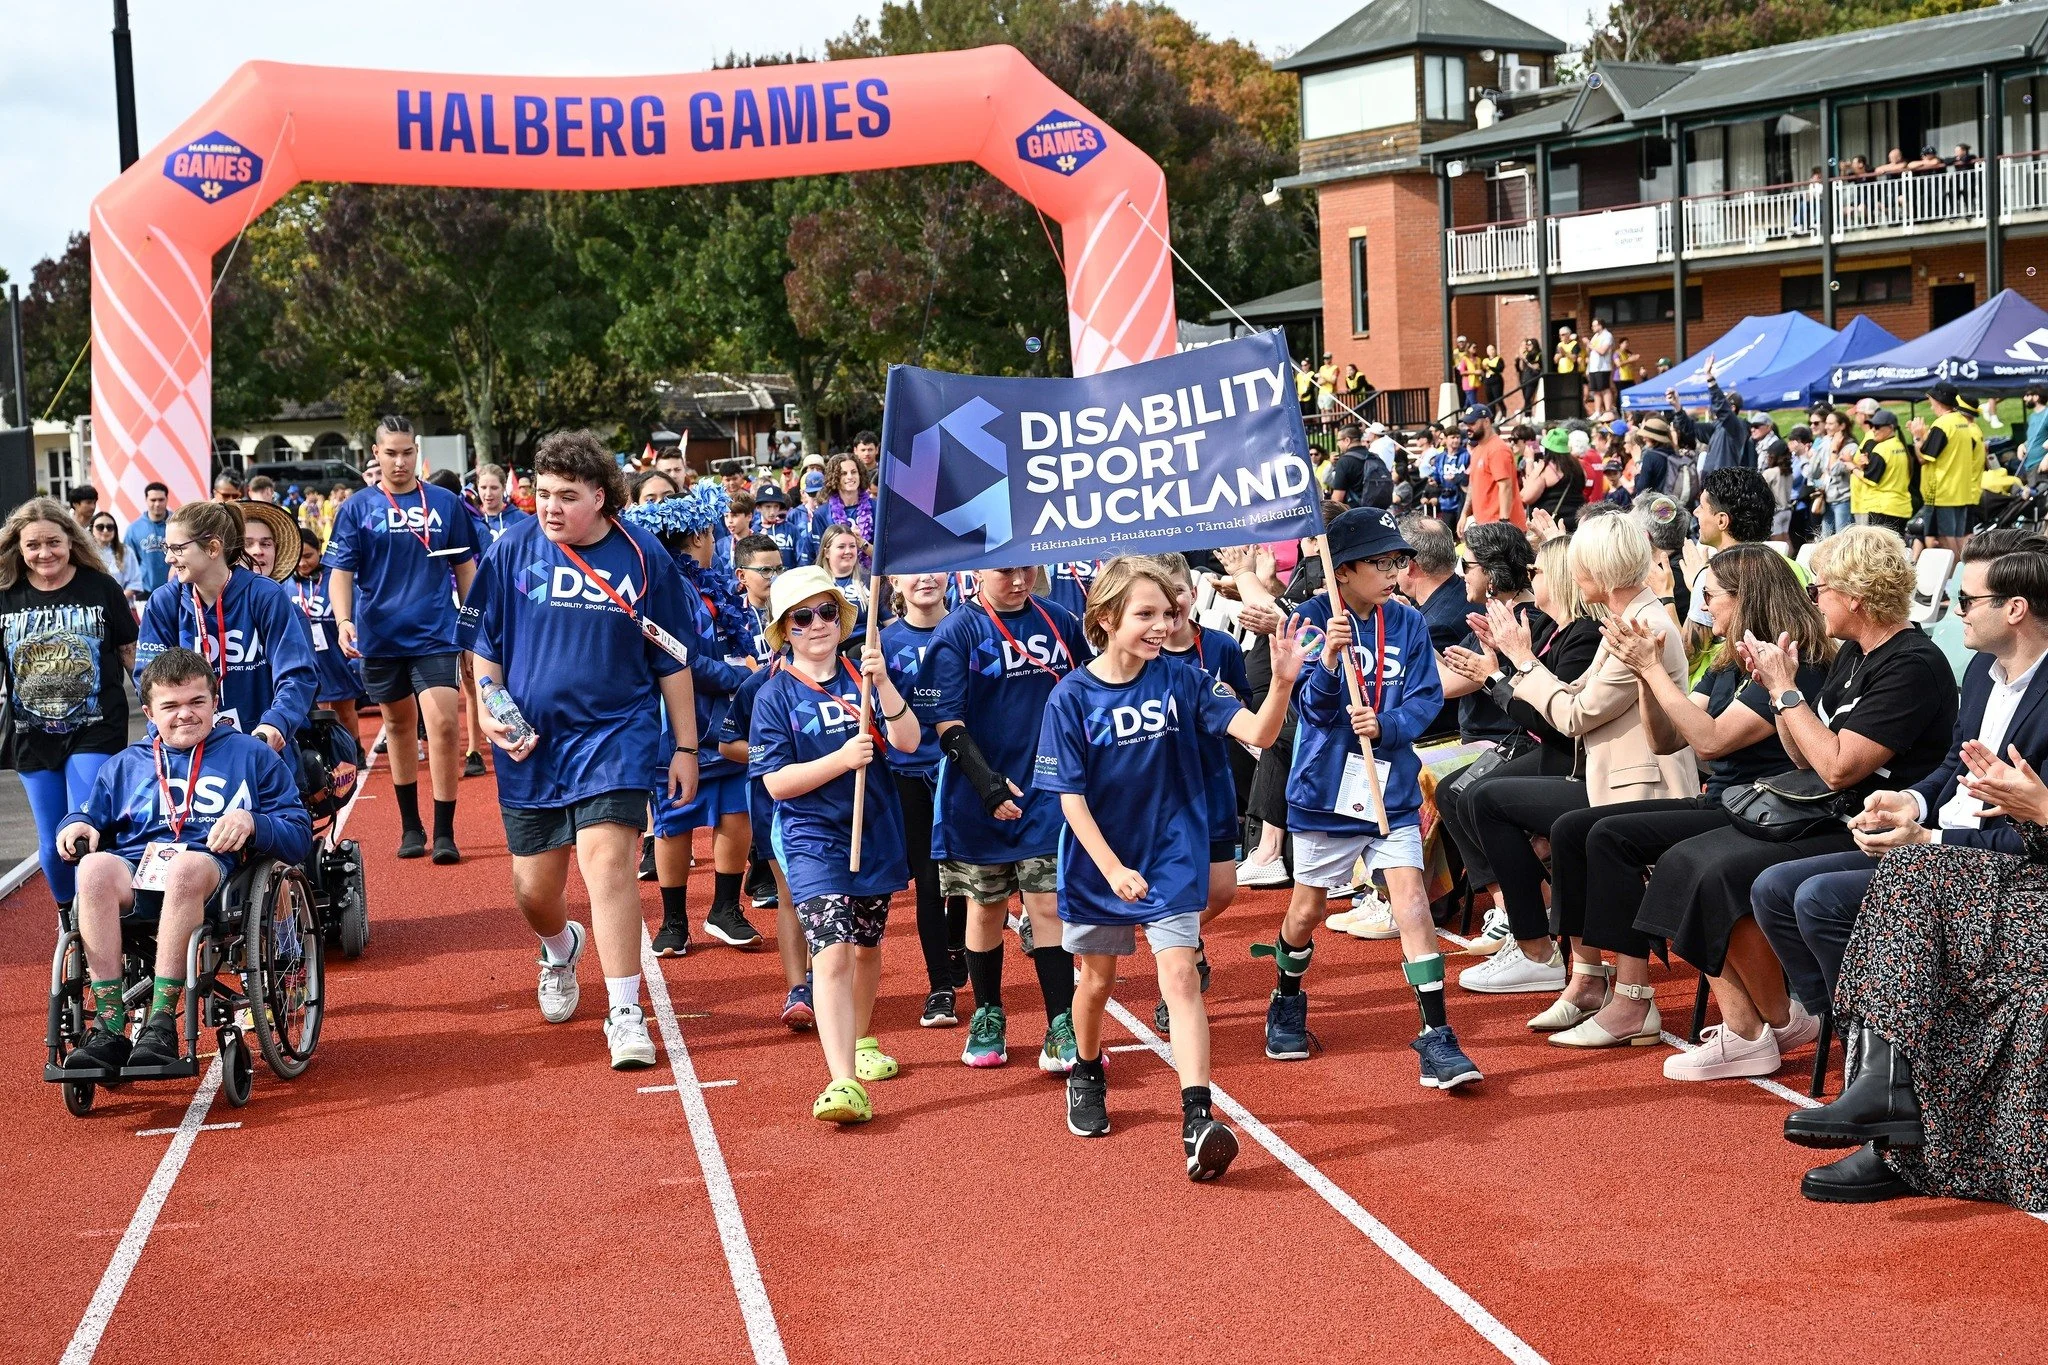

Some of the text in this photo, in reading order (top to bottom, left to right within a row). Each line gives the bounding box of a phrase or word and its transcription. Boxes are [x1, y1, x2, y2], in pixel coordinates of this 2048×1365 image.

[397, 78, 891, 157] HALBERG GAMES
[1036, 120, 1081, 132] HALBERG
[188, 144, 241, 154] HALBERG
[1026, 128, 1098, 158] GAMES
[174, 153, 252, 182] GAMES
[1020, 362, 1285, 450] DISABILITY
[1026, 430, 1206, 494] SPORT
[1031, 454, 1310, 536] AUCKLAND
[388, 506, 442, 528] DSA
[1031, 504, 1313, 552] Hākinakina Hauātanga o Tāmaki Makaurau
[552, 566, 638, 604] DSA
[550, 600, 582, 609] DISABILITY
[585, 603, 606, 612] SPORT
[195, 628, 264, 663] DSA
[1002, 634, 1067, 670] DSA
[1006, 670, 1031, 679] DISABILITY
[1112, 694, 1179, 738] DSA
[1117, 736, 1147, 747] DISABILITY
[1148, 731, 1165, 741] SPORT
[159, 776, 252, 816] DSA
